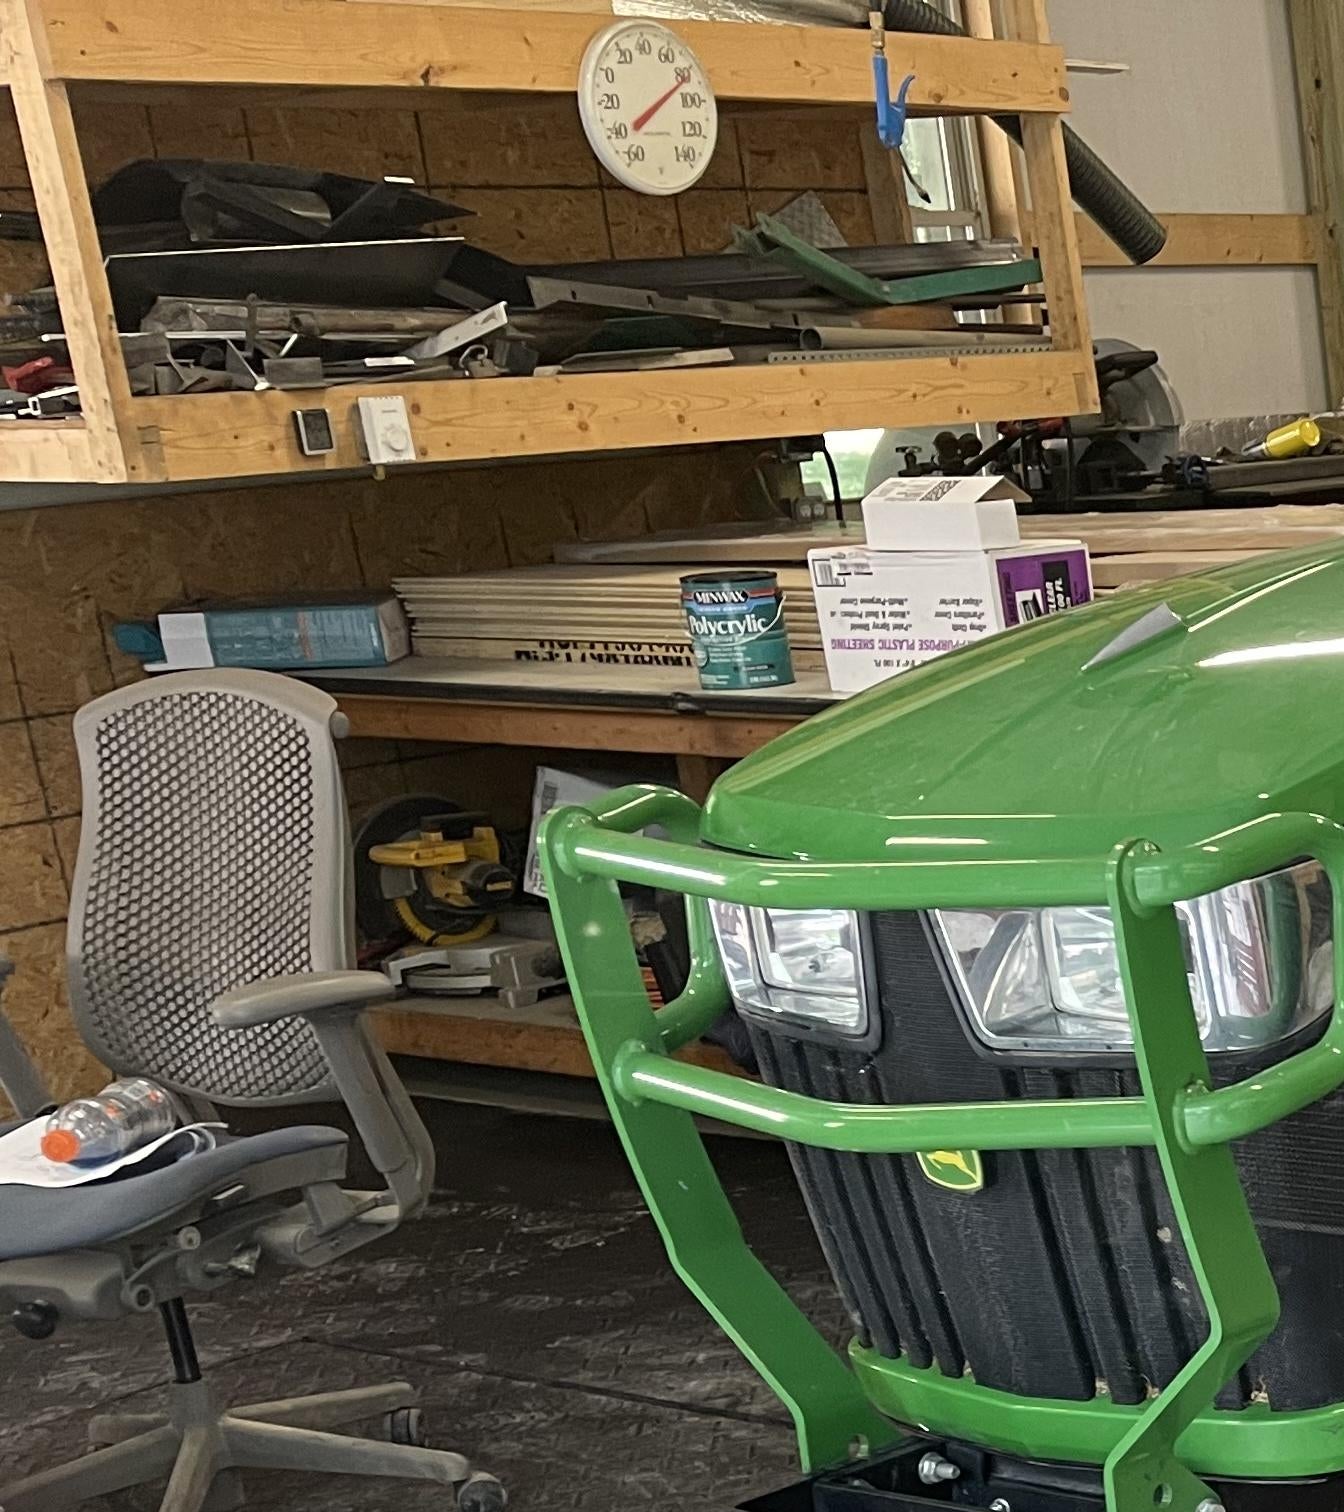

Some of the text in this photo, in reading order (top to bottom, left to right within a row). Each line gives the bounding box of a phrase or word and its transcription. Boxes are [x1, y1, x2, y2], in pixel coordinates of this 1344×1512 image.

[635, 38, 651, 55] 40
[616, 49, 633, 64] 20
[658, 47, 674, 64] 60
[604, 67, 615, 83] 0
[674, 67, 692, 84] 80
[680, 92, 701, 108] 100
[681, 121, 702, 137] 120
[674, 145, 696, 162] 140
[695, 591, 746, 604] MINWAX
[688, 613, 768, 638] Polycrylic
[878, 638, 915, 650] PLASTIC
